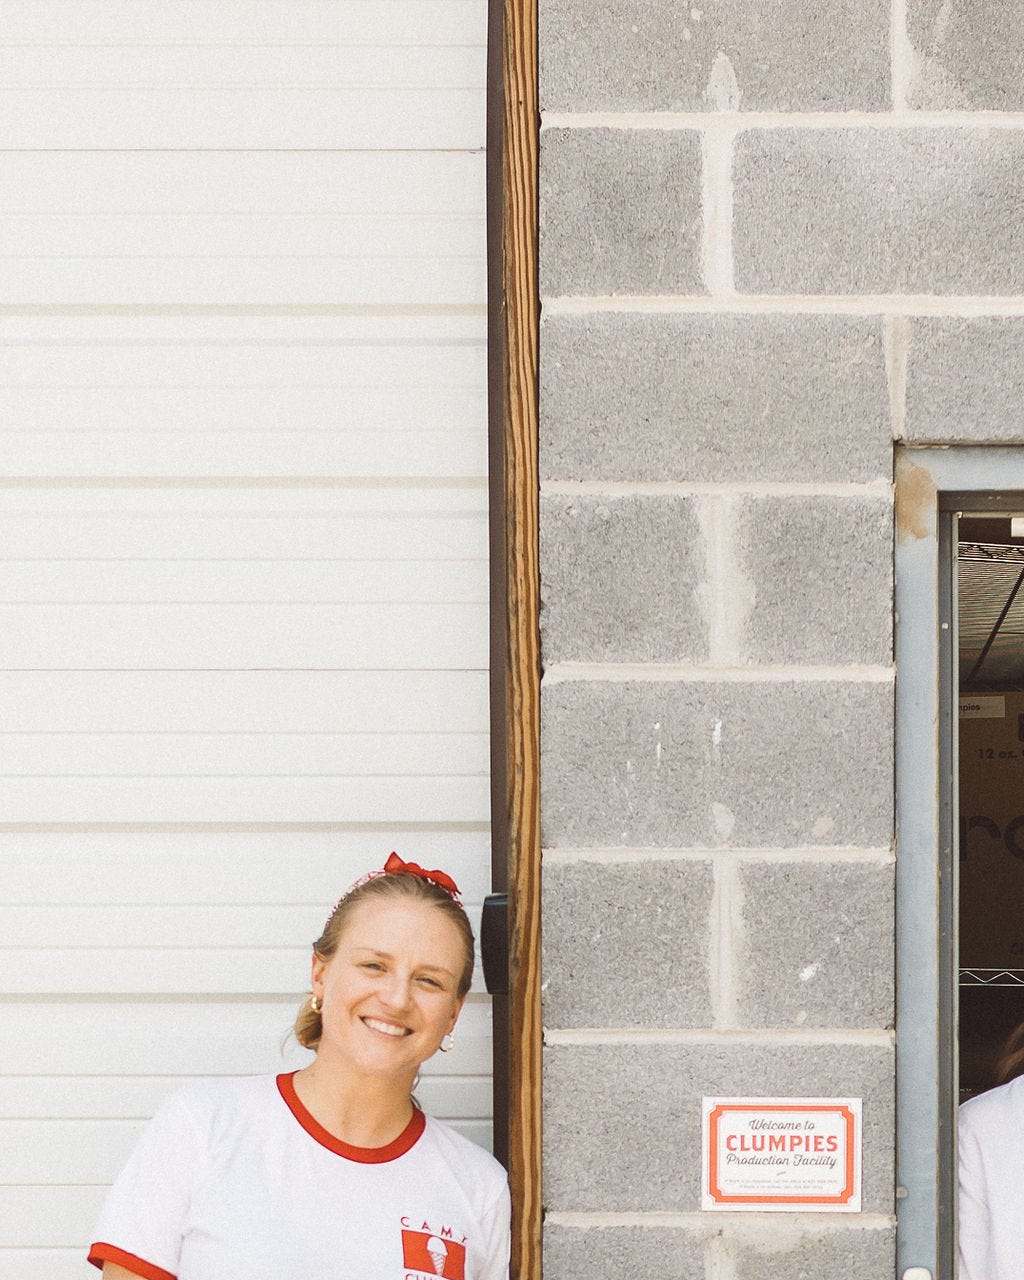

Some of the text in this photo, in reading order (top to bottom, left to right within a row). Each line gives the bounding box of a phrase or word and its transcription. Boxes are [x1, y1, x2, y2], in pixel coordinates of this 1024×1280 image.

[978, 748, 994, 759] 12
[998, 751, 1018, 759] oz.
[748, 1118, 815, 1130] Welcome to
[726, 1134, 838, 1152] CLUMPIES
[726, 1153, 838, 1169] Production Facility
